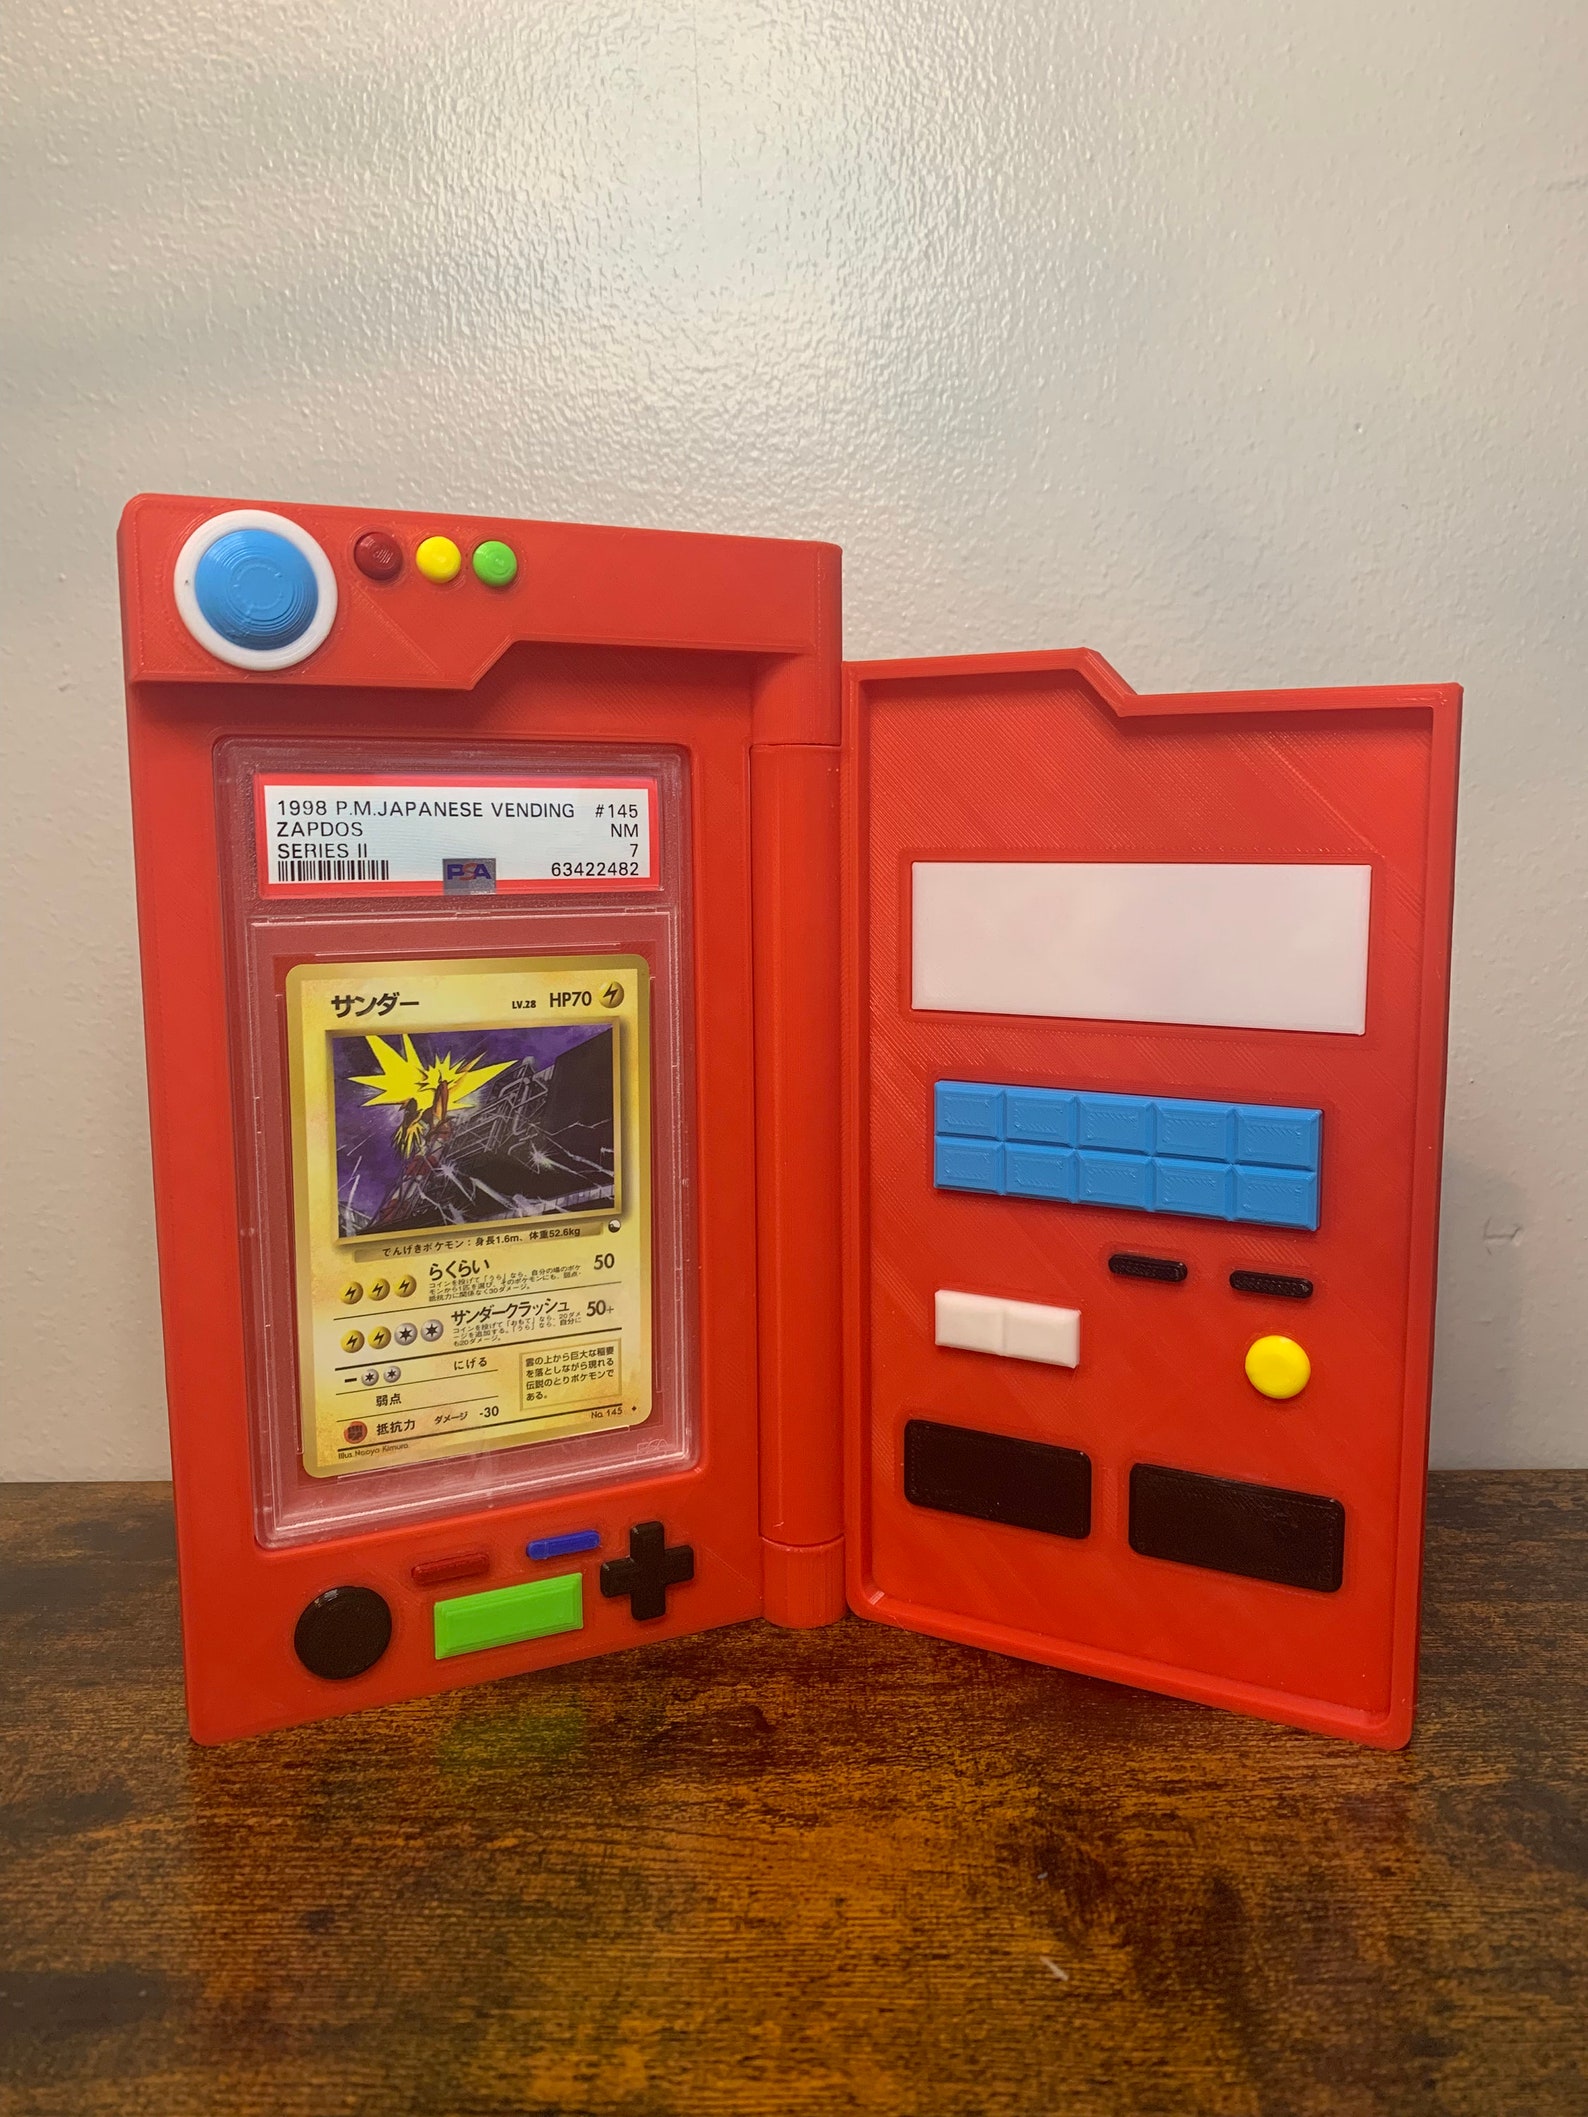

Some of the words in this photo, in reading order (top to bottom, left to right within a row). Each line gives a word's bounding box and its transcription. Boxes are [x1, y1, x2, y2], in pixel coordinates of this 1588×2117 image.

[278, 799, 327, 817] 1998
[336, 800, 484, 818] P.M.JAPANESE
[492, 801, 575, 819] VENDING
[595, 803, 639, 819] #145
[276, 821, 363, 838] ZAPDOS
[610, 823, 639, 838] NM
[277, 843, 349, 859] SERIES
[358, 843, 368, 858] II
[630, 843, 639, 858] 7
[447, 862, 492, 881] PSA
[551, 861, 640, 877] 63422482
[331, 992, 420, 1018] サンダー
[512, 1000, 537, 1010] LV.28
[549, 991, 592, 1008] HP70
[429, 1259, 490, 1281] らくらい
[593, 1253, 615, 1271] 50
[451, 1298, 570, 1326] サンダークラッシュ
[586, 1300, 615, 1317] 50+
[454, 1356, 487, 1371] にげる
[525, 1358, 614, 1378] を落としながら現れる
[375, 1393, 402, 1407] 弱点
[526, 1391, 547, 1401] ある。
[606, 1407, 623, 1417] 145
[376, 1419, 416, 1436] 抵抗力
[434, 1411, 468, 1425] ダメージ
[479, 1406, 500, 1418] -30
[382, 1443, 409, 1453] Kimura
